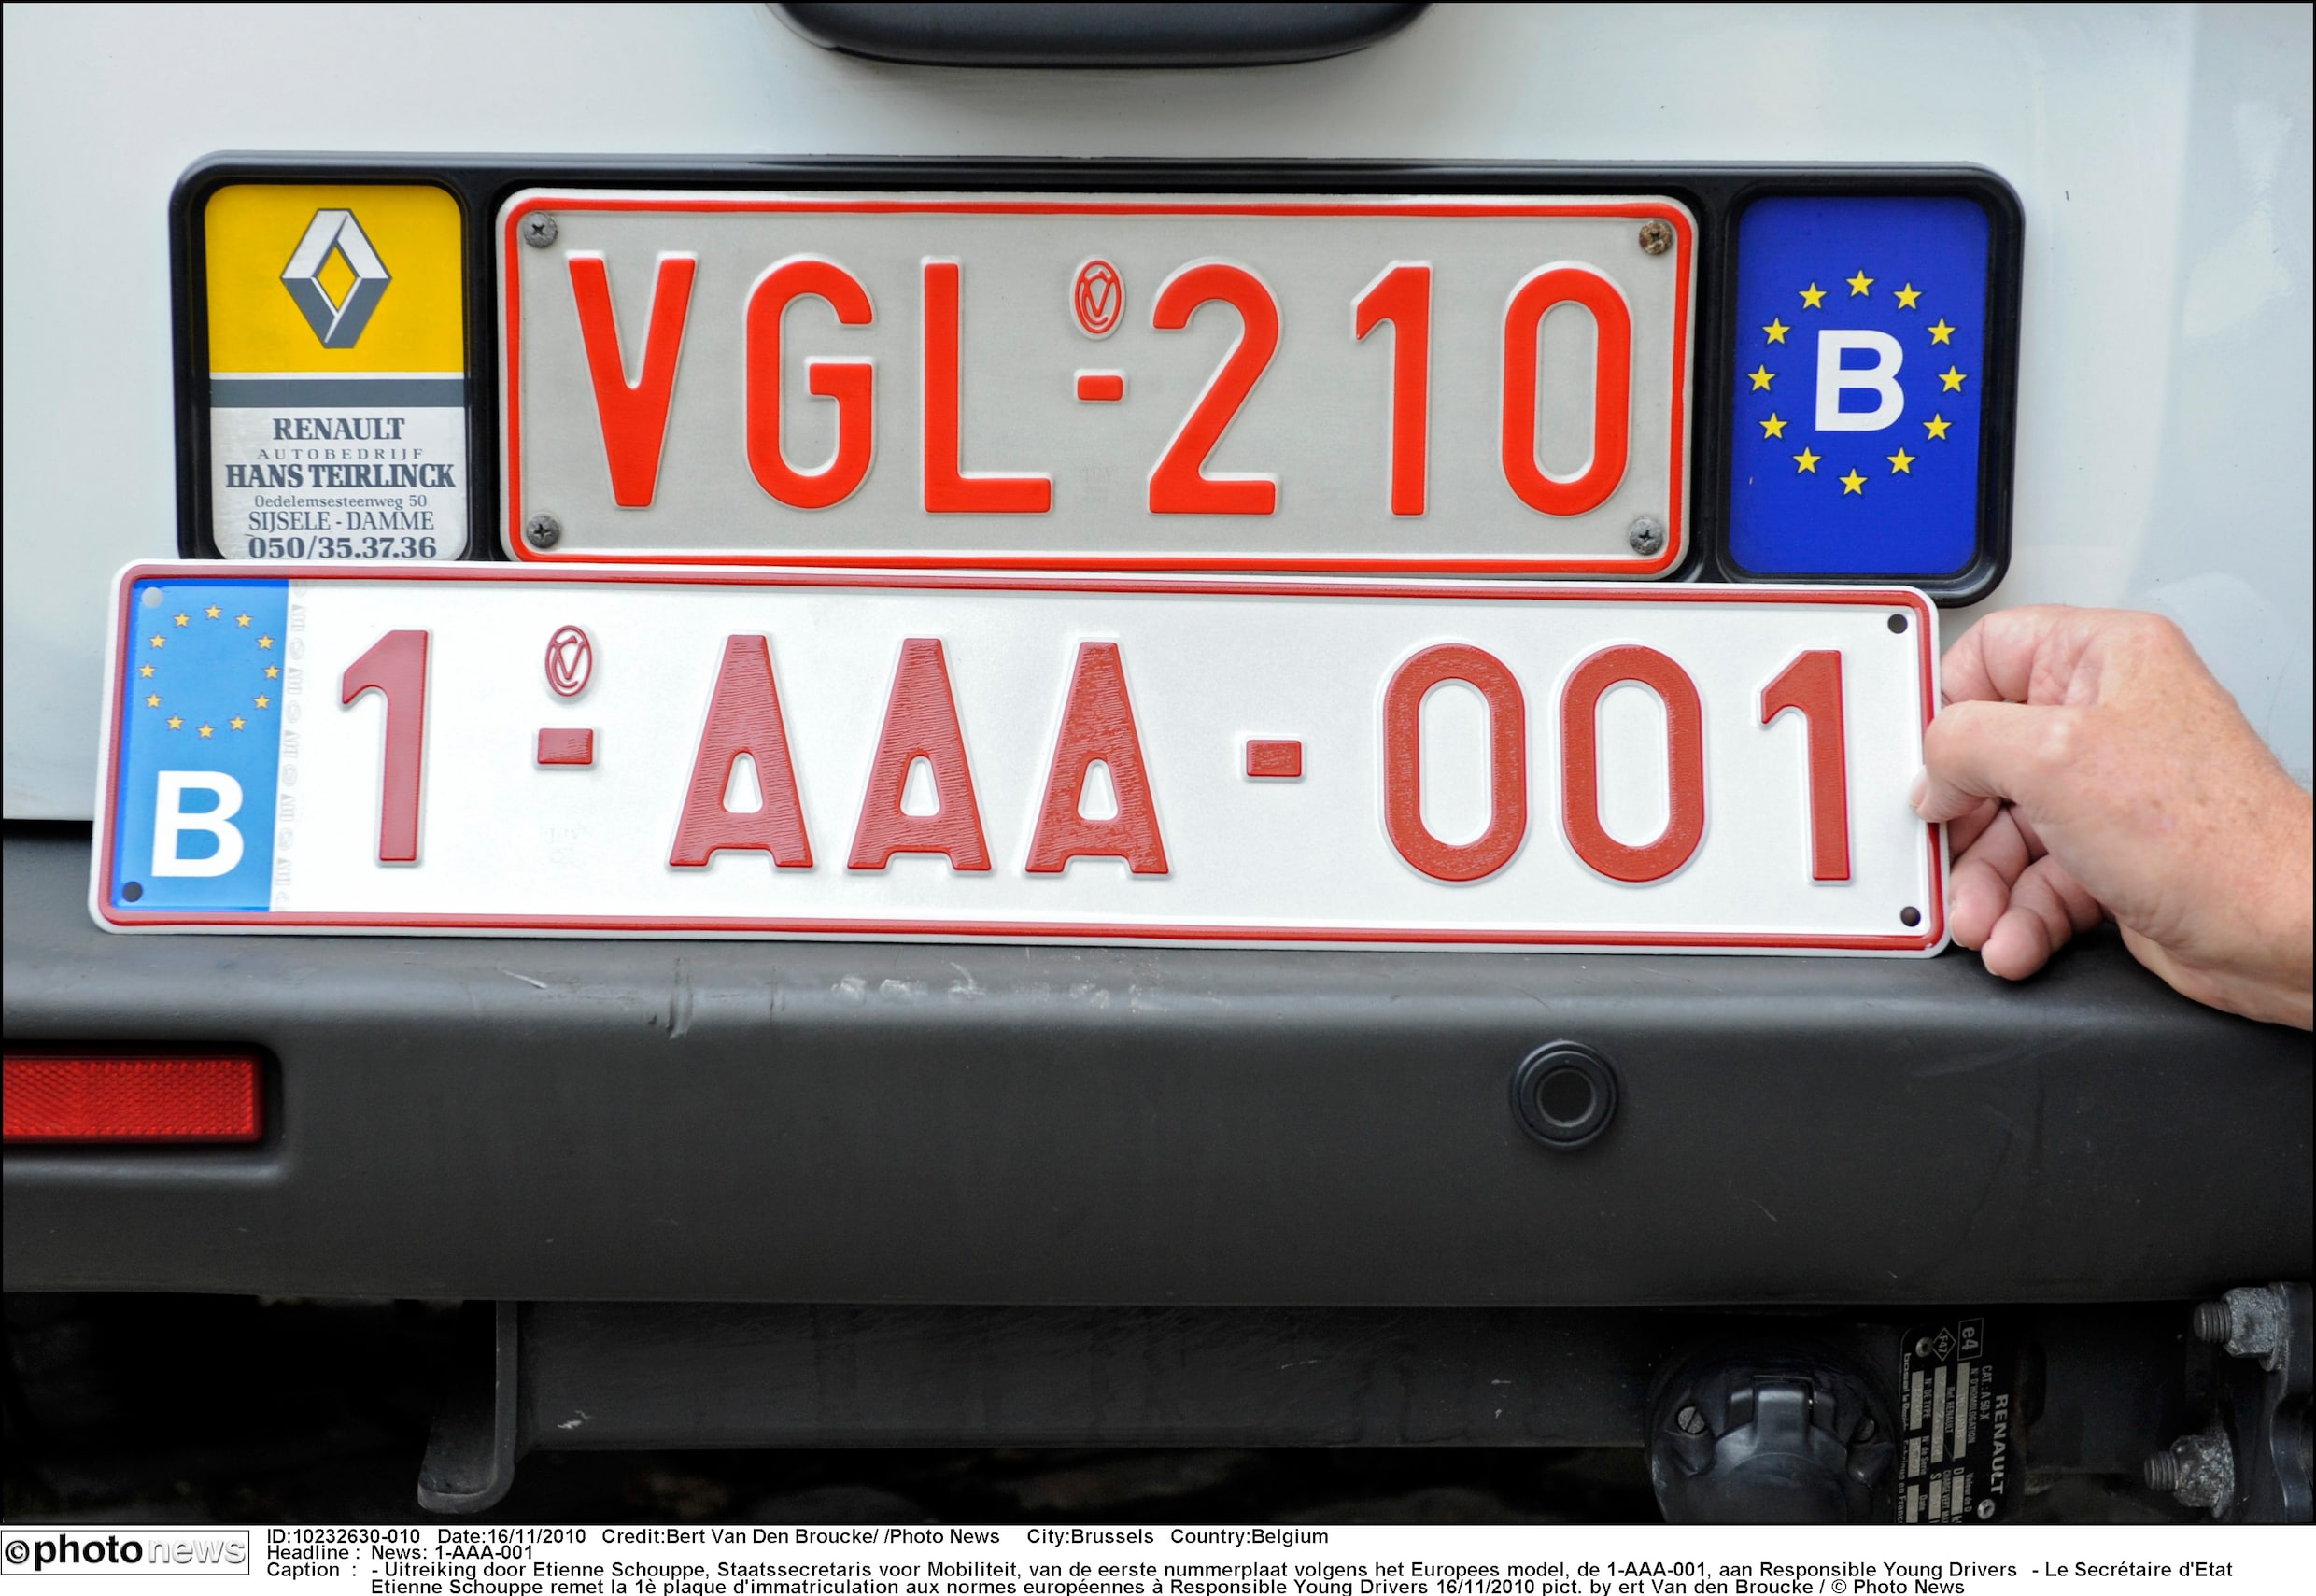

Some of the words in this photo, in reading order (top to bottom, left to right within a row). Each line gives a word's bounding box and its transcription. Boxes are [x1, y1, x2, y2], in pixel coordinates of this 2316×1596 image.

[569, 258, 1631, 516] VGL-210
[1815, 330, 1905, 431] B
[273, 417, 405, 441] RENAULT
[257, 448, 424, 460] AUTOBEDRIJF
[225, 463, 304, 488] HANS
[307, 463, 456, 488] TEIRLINCK
[409, 494, 428, 507] 50
[248, 511, 331, 533] SIJSELE
[347, 511, 434, 530] DAMME
[248, 535, 437, 559] 050/35.37.36
[341, 629, 1851, 883] 1-AAA-001
[151, 770, 245, 877] B
[1938, 1335, 1948, 1353] F47
[1961, 1326, 1979, 1350] e4
[1990, 1393, 2009, 1494] RENAULT
